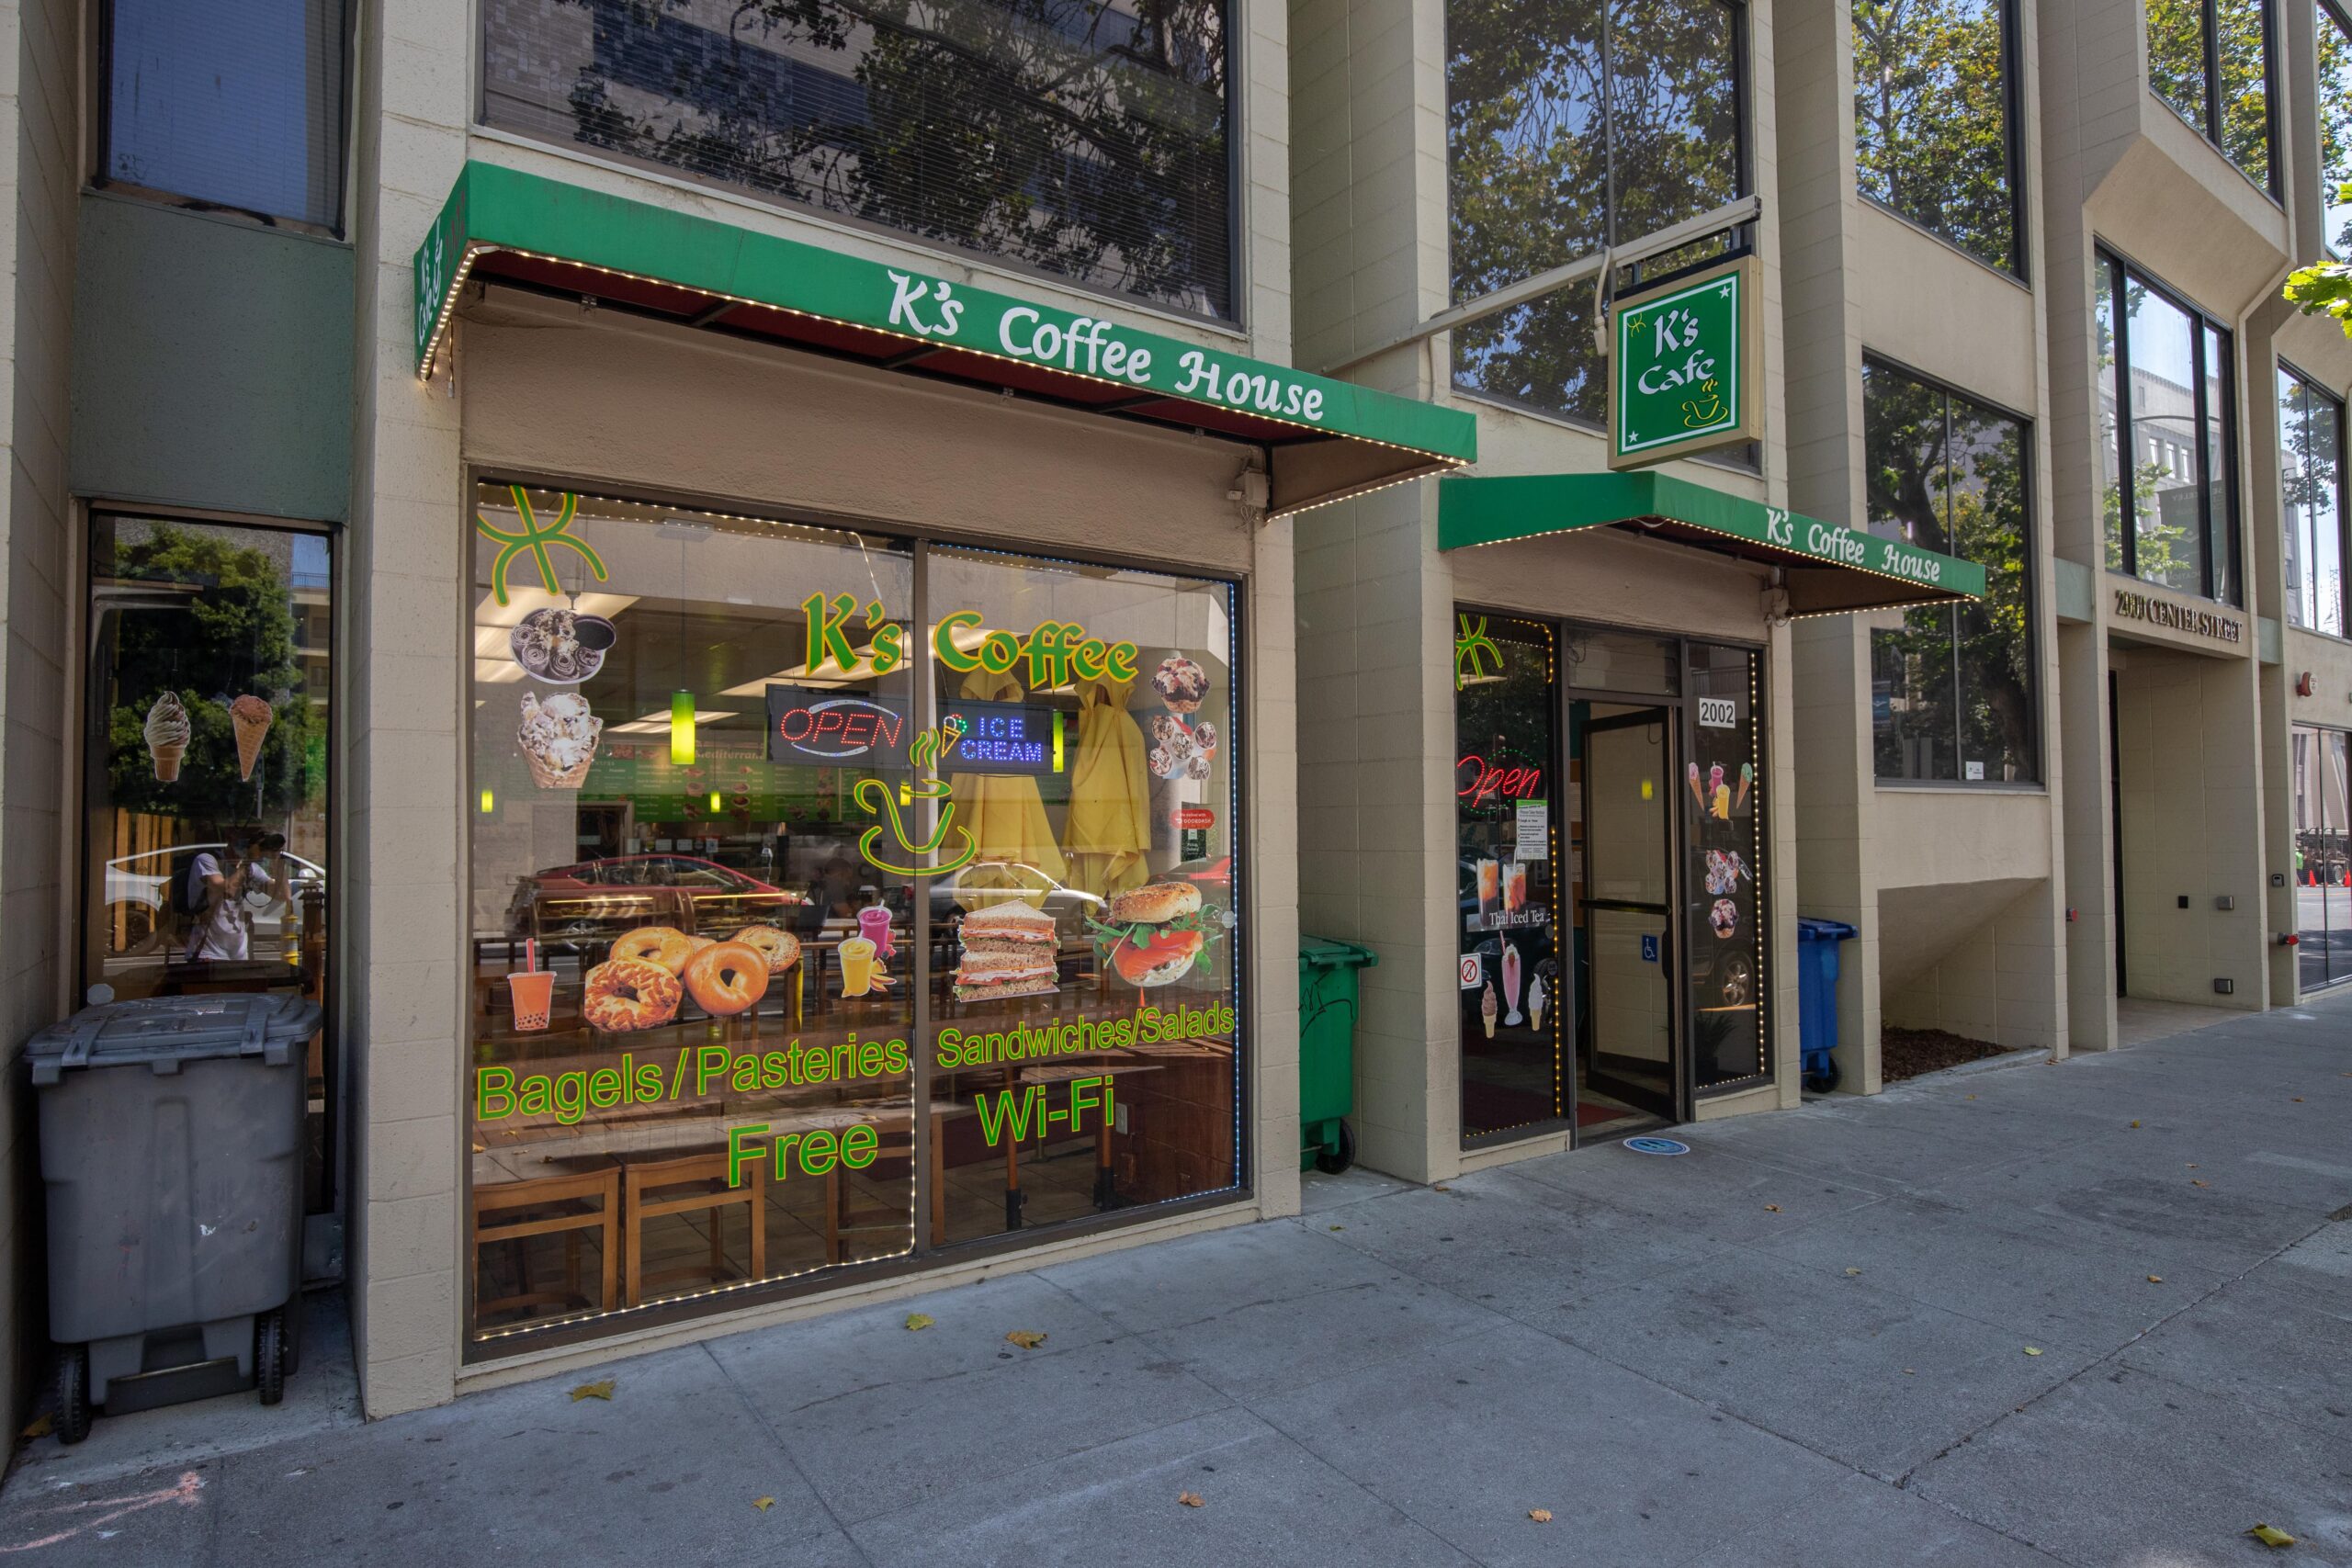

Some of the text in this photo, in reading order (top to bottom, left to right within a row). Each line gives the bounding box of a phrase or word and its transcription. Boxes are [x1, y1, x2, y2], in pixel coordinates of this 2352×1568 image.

[888, 268, 1325, 422] K's Coffee House
[1653, 308, 1700, 359] K's
[1637, 349, 1715, 395] Cafe
[1766, 507, 1940, 582] K's Coffee House
[800, 591, 1139, 691] K's Coffee
[2146, 598, 2199, 634] CENTER
[2199, 611, 2243, 643] STREET
[780, 707, 903, 749] OPEN
[978, 716, 1024, 739] ICE
[1701, 702, 1735, 724] 2002
[960, 739, 1044, 763] CREAM
[1457, 755, 1541, 809] Open
[1488, 909, 1544, 926] Thai Iced Tea
[728, 1075, 1115, 1189] Free Wi-Fi
